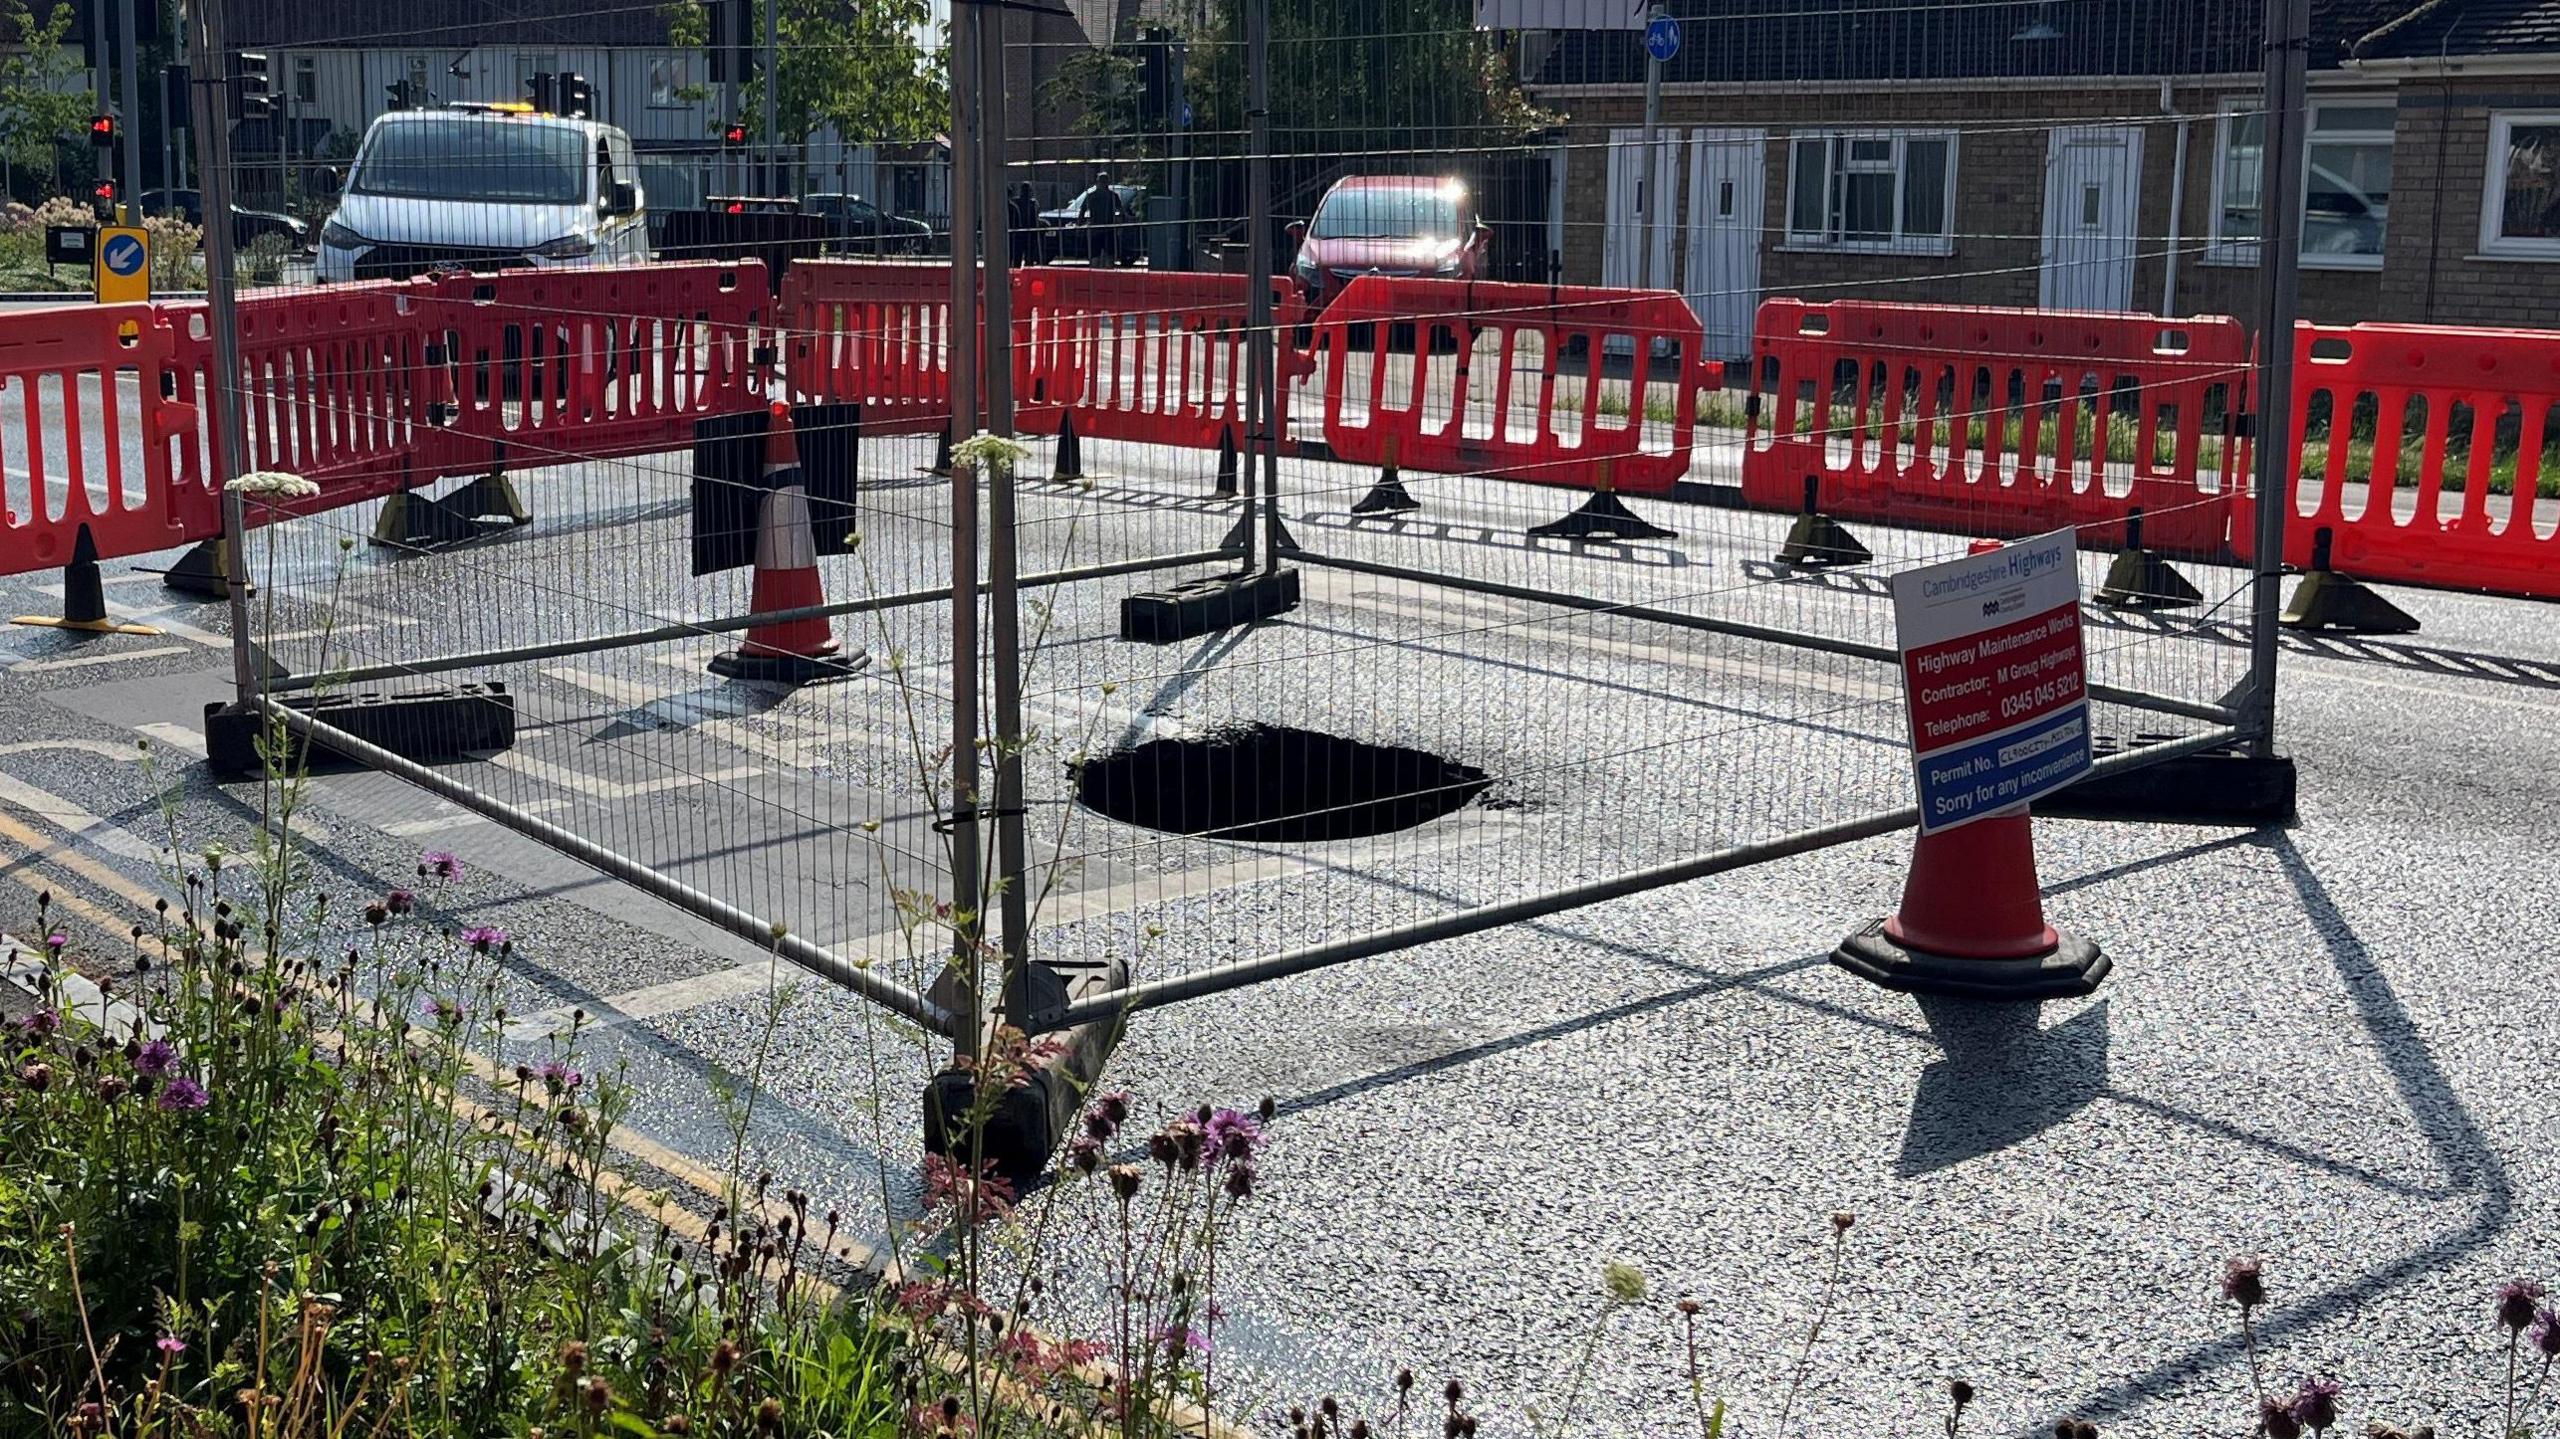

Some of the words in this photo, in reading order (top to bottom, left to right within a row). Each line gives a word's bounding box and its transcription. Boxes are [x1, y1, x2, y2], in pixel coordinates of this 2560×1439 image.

[1923, 565, 2007, 598] Cambridgeshire
[2008, 546, 2062, 577] Highways
[1917, 648, 1976, 674] Highway
[1978, 625, 2047, 657] Maintenance
[2048, 614, 2074, 635] Works
[1921, 676, 1991, 704] Contractor:
[1997, 667, 2008, 684] M
[2010, 660, 2039, 681] Group
[2040, 645, 2077, 669] Highways
[1924, 709, 1991, 738] Telephone:
[2001, 690, 2033, 718] 0345
[2034, 680, 2056, 707] 045
[2056, 671, 2080, 698] 5212
[1931, 761, 1973, 786] Permit
[1974, 756, 1995, 774] No.
[1935, 790, 1974, 815] Sorry
[1975, 784, 1995, 801] for
[1998, 776, 2019, 796] any
[2020, 748, 2085, 788] inconvenience
